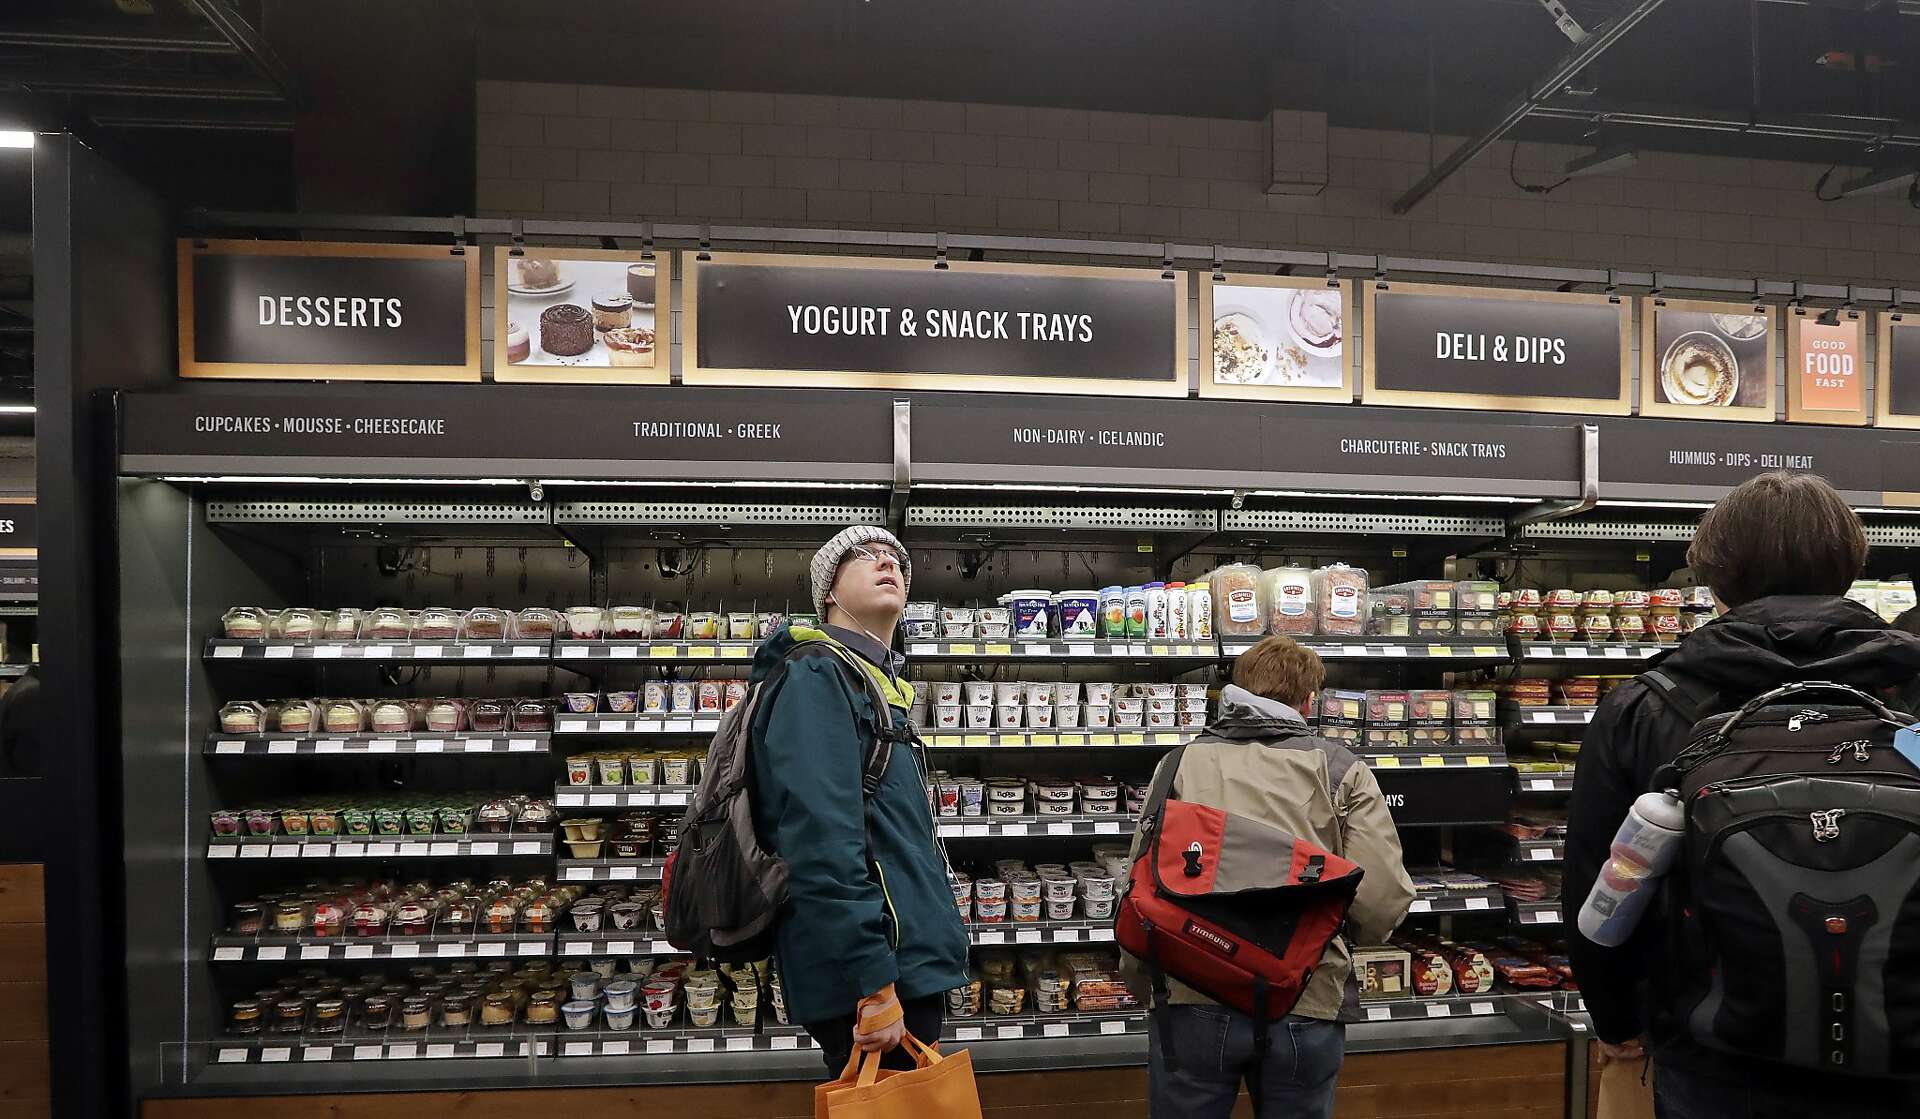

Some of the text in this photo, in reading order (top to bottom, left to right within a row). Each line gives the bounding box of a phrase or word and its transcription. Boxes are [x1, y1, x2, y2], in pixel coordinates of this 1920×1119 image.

[258, 295, 403, 329] DESSERTS
[787, 305, 1093, 343] YOGURT & SNACK TRAYS
[1436, 332, 1566, 365] DELI & DIPS
[1812, 340, 1846, 350] GOOD
[1805, 352, 1854, 376] FOOD
[1815, 378, 1845, 388] FAST
[195, 416, 445, 436] CUPCAKES MOUSSE CHEESECAKE
[632, 421, 781, 440] TRADITIONAL GREEK
[1013, 427, 1165, 447] NON-DAIRY ICELANDIC
[1340, 438, 1506, 458] CHARCUTERIE SNACK TRAYS
[1669, 450, 1813, 469] HUMMUS DIPS DELI MEAT
